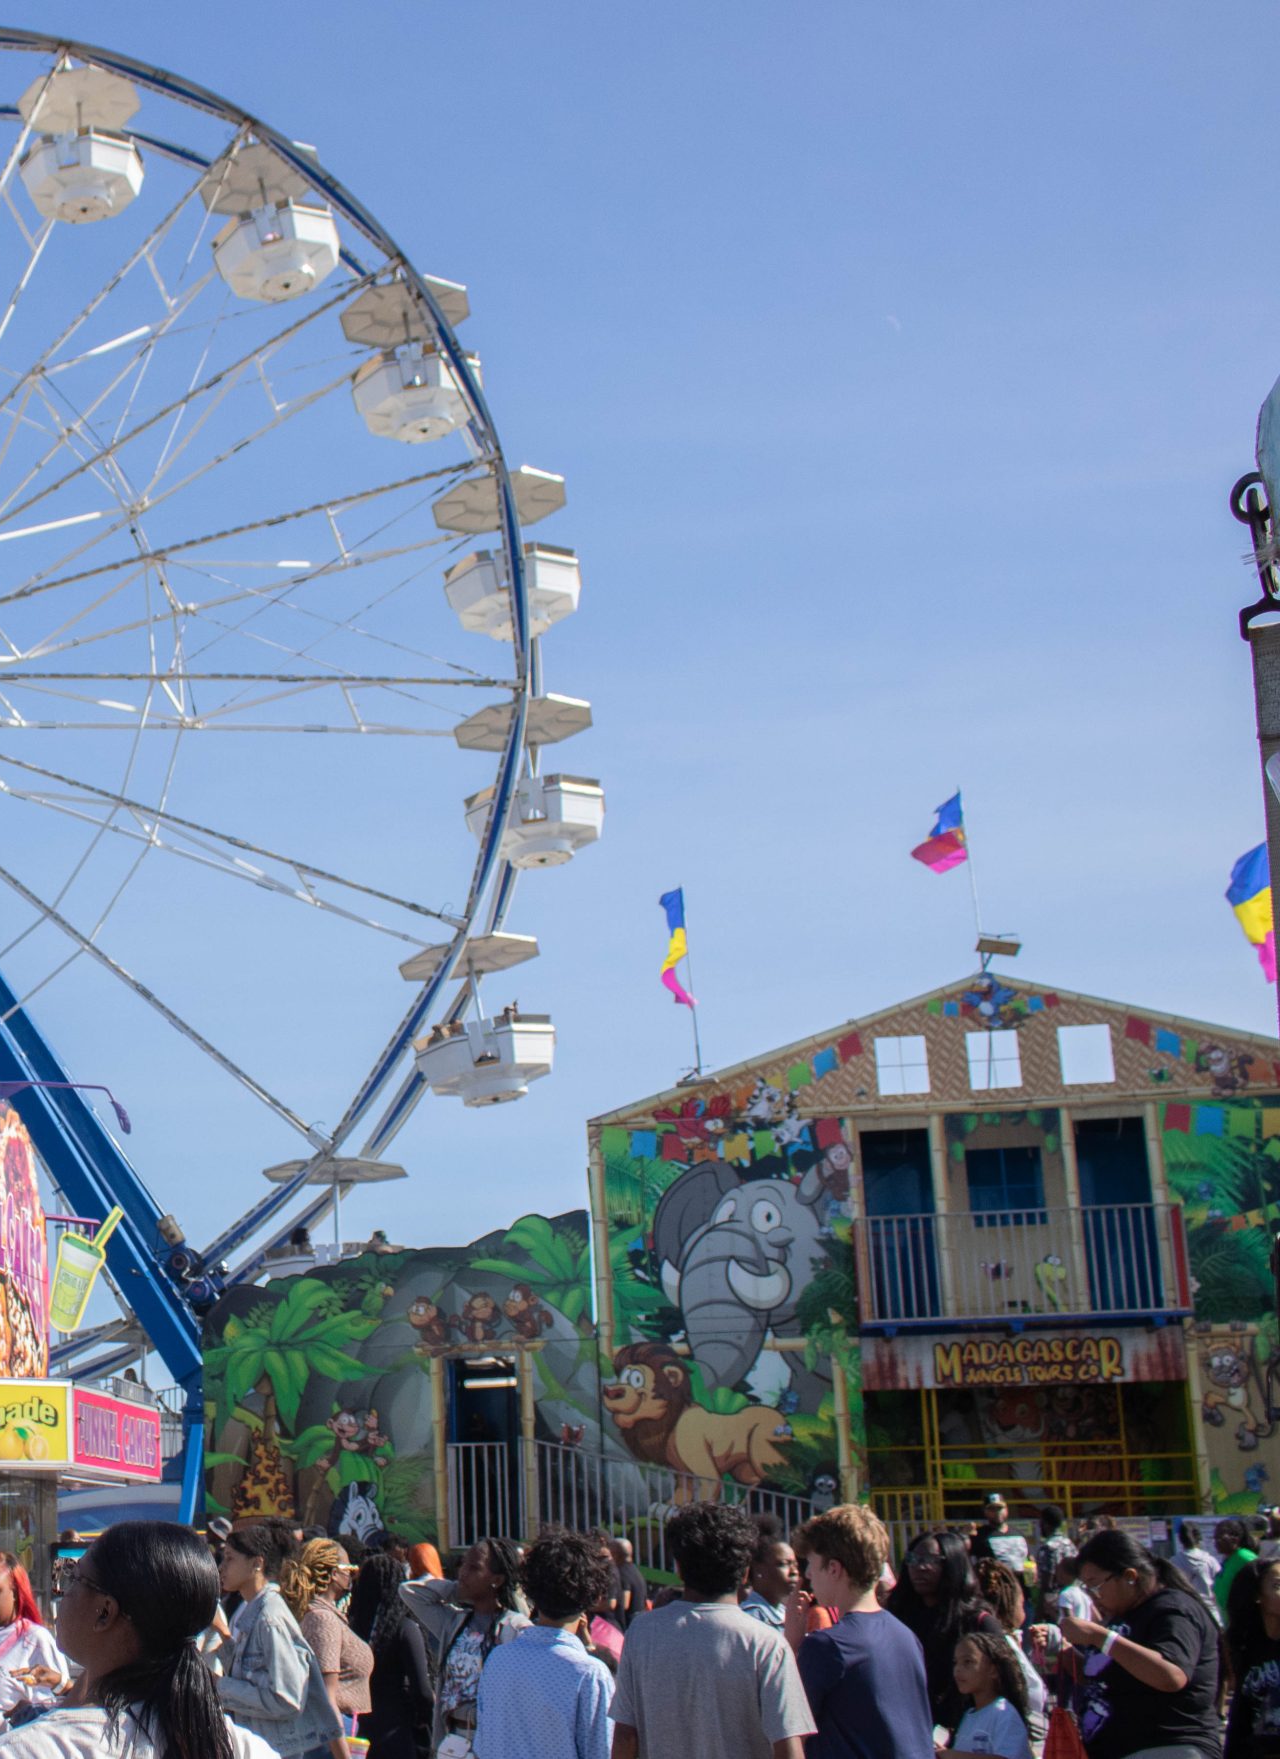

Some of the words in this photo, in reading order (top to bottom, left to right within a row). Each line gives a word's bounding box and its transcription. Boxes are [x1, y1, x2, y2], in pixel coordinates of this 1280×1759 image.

[933, 1337, 1124, 1384] MADAGASCAR
[966, 1366, 1022, 1383] JUNGLE
[77, 1402, 120, 1463] FUNNEL
[122, 1413, 156, 1469] CAKES
